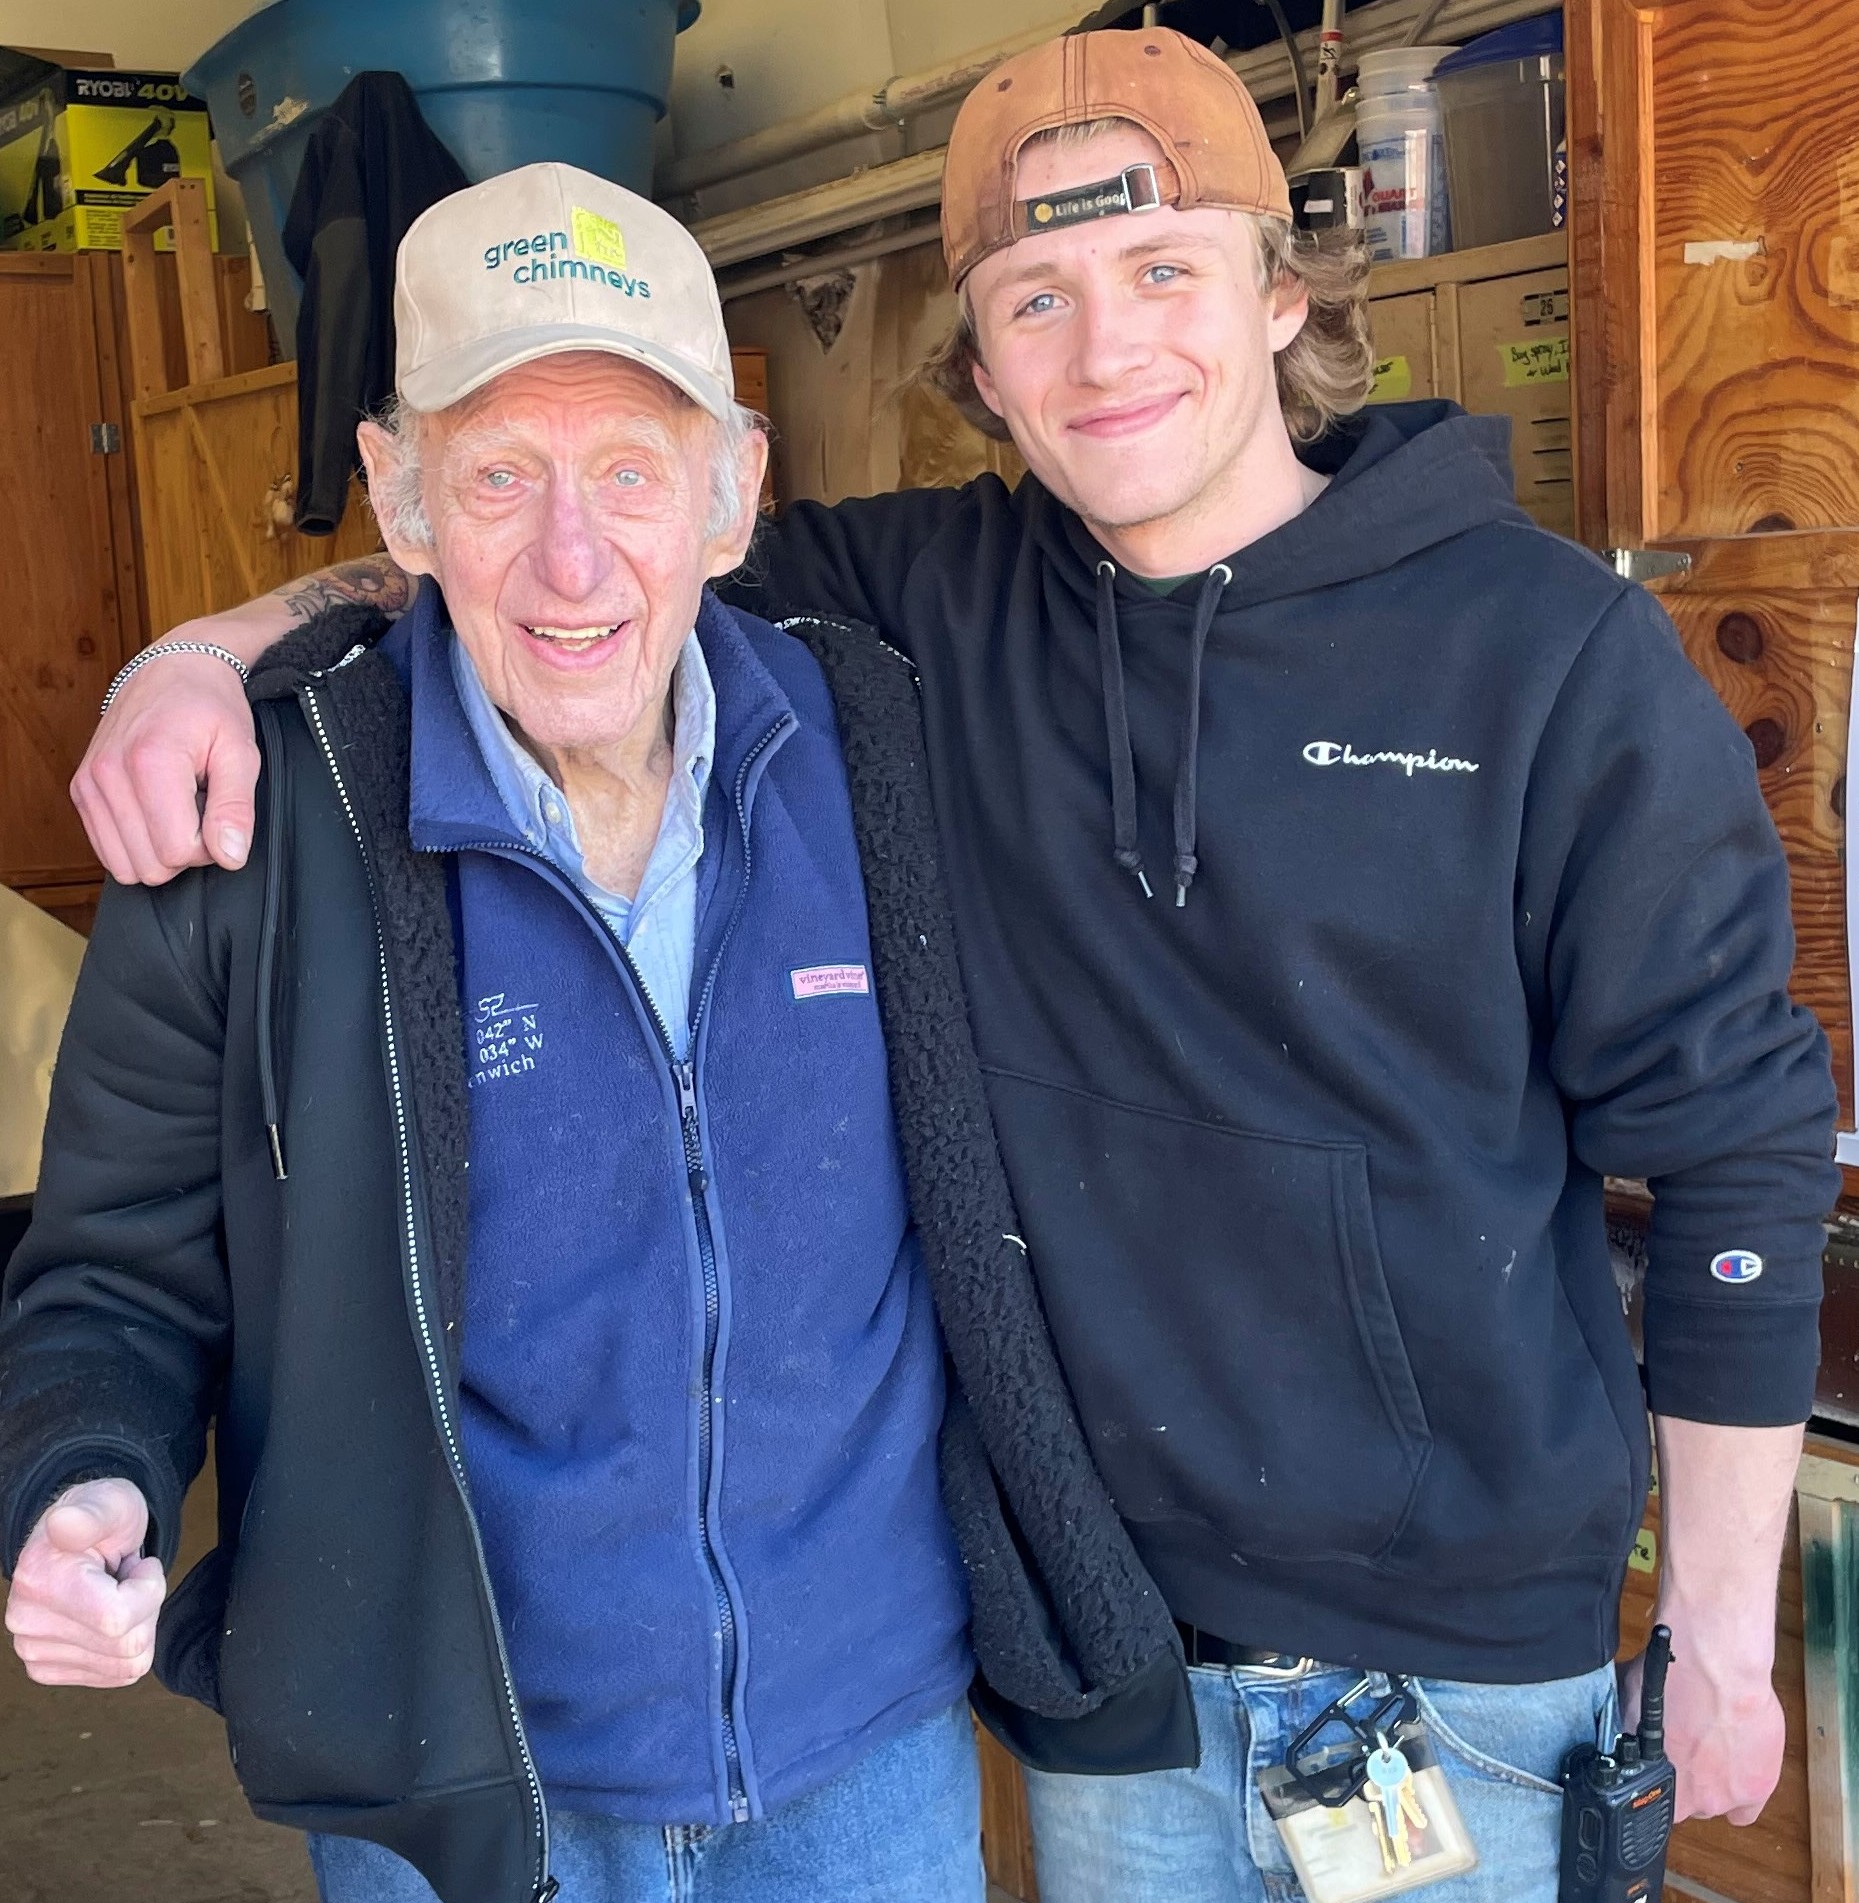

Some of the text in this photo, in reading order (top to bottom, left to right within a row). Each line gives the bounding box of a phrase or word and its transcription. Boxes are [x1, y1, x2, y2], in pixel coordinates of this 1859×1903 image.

[76, 79, 133, 98] RYOBI
[1055, 201, 1079, 217] Life
[1082, 198, 1093, 210] is
[484, 231, 568, 270] green
[513, 253, 651, 298] chimneys
[1302, 741, 1480, 777] Champion
[799, 969, 846, 985] vineyard
[522, 1014, 536, 1031] N
[524, 1033, 543, 1050] W
